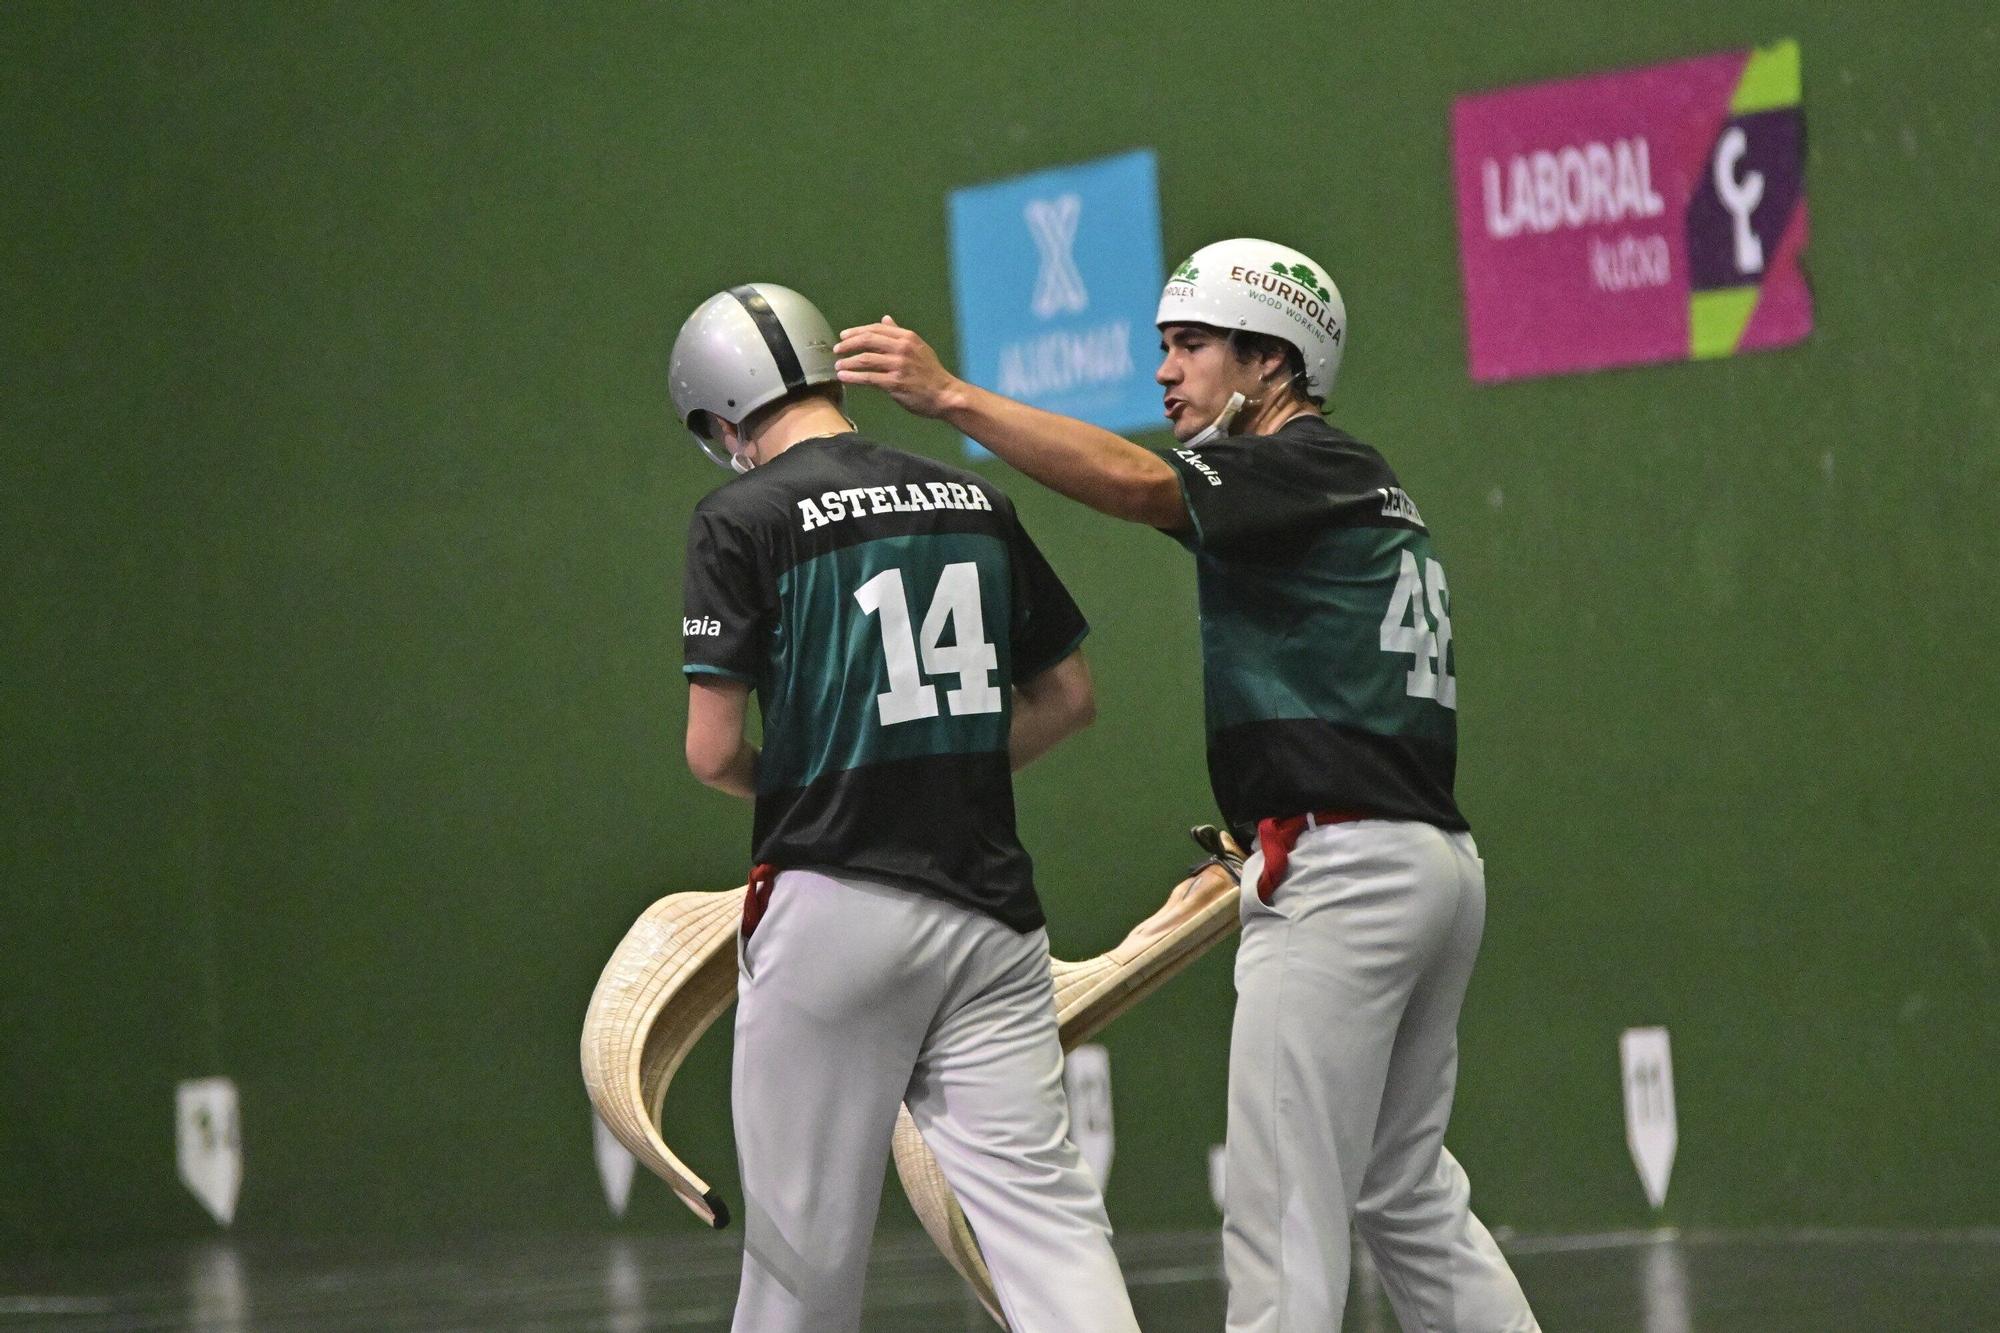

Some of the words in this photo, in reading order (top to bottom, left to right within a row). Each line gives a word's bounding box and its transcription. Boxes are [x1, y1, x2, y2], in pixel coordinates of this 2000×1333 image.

[1482, 136, 1665, 238] LABORAL
[1230, 265, 1342, 347] EGURROLEA
[1248, 288, 1283, 311] WOOD
[1285, 306, 1326, 344] WORKING
[1171, 447, 1222, 486] zkaia
[797, 481, 993, 532] ASTELARRA
[853, 561, 1002, 726] 14
